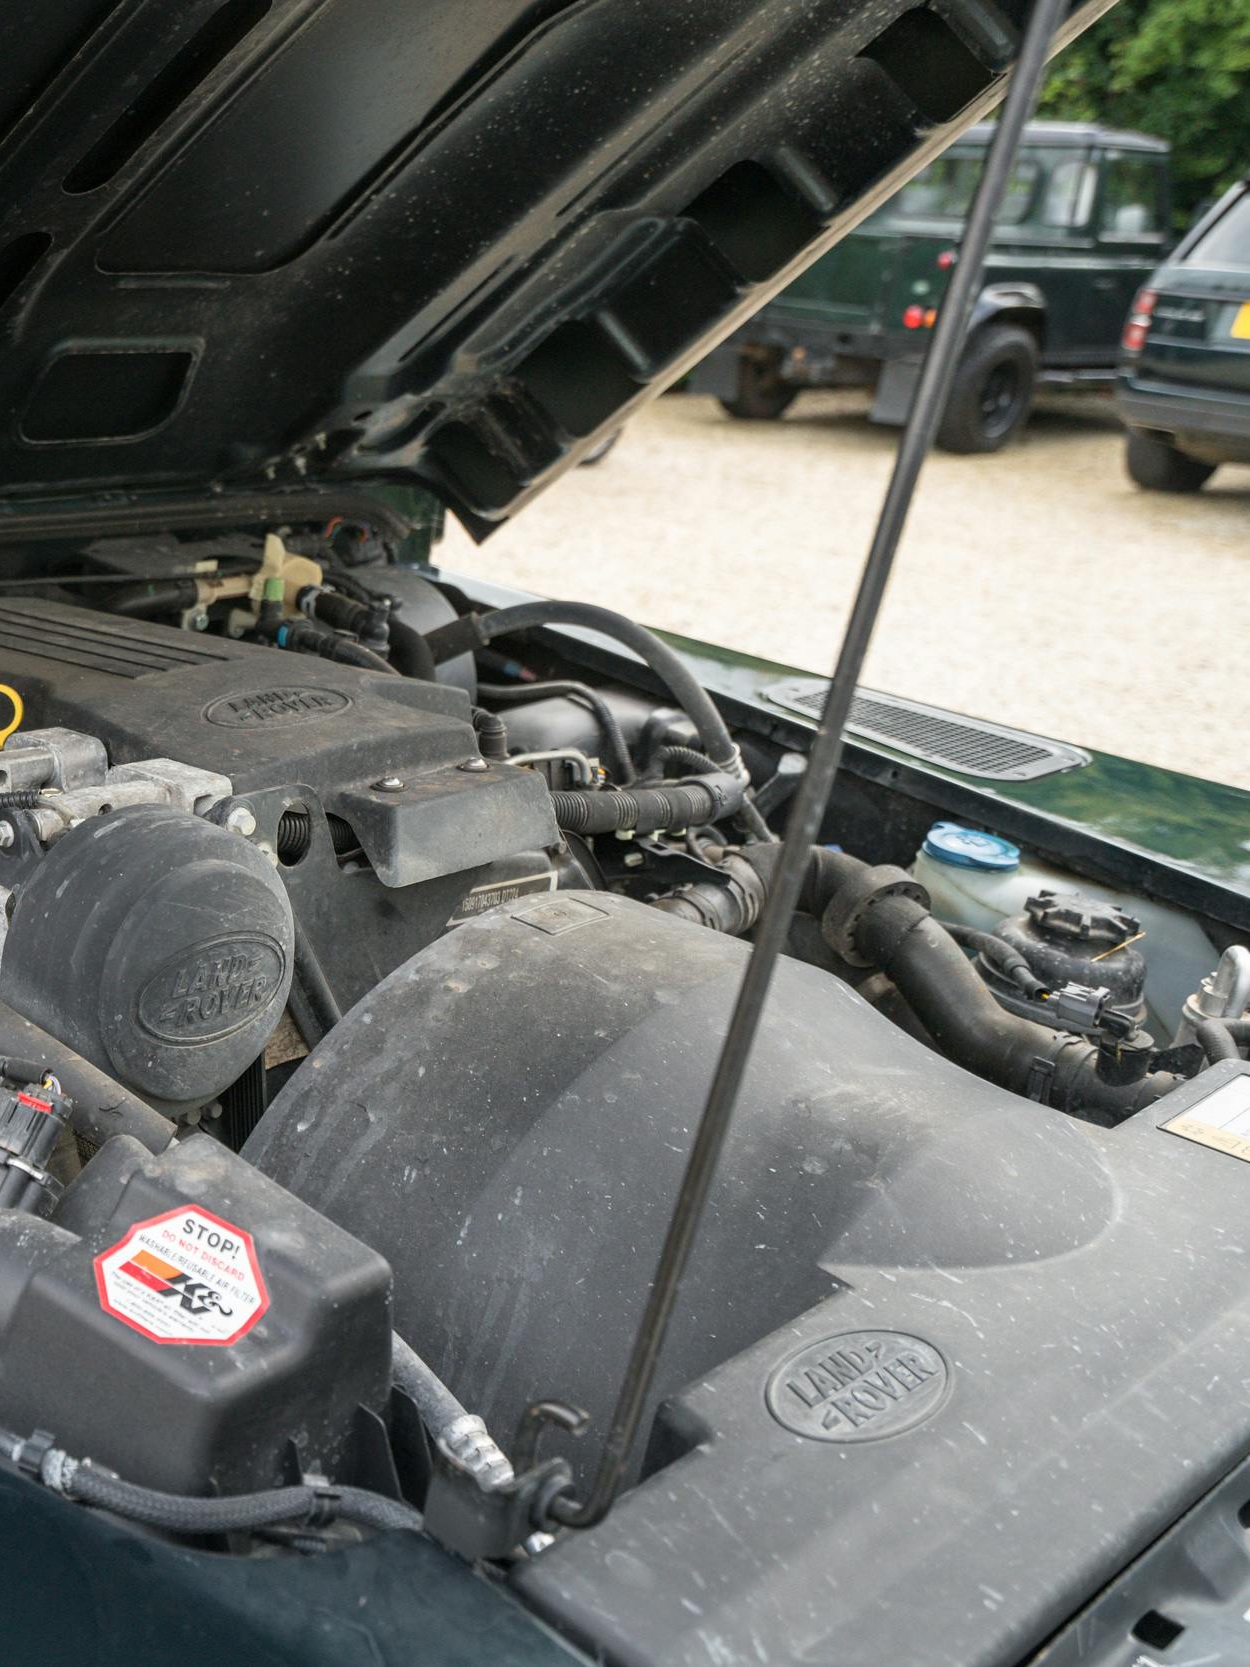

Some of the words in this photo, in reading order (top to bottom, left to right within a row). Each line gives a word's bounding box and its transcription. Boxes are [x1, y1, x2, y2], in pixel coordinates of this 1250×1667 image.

[171, 954, 248, 999] LAND
[174, 975, 267, 1028] ROVER
[161, 1229, 176, 1243] DO
[178, 1238, 199, 1255] NOT
[200, 1250, 246, 1282] DISCARD
[182, 1218, 241, 1260] STOP!
[215, 1275, 230, 1290] AIR
[231, 1285, 256, 1305] FILTER
[786, 1351, 874, 1409] LAND
[830, 1353, 940, 1428] ROVER
